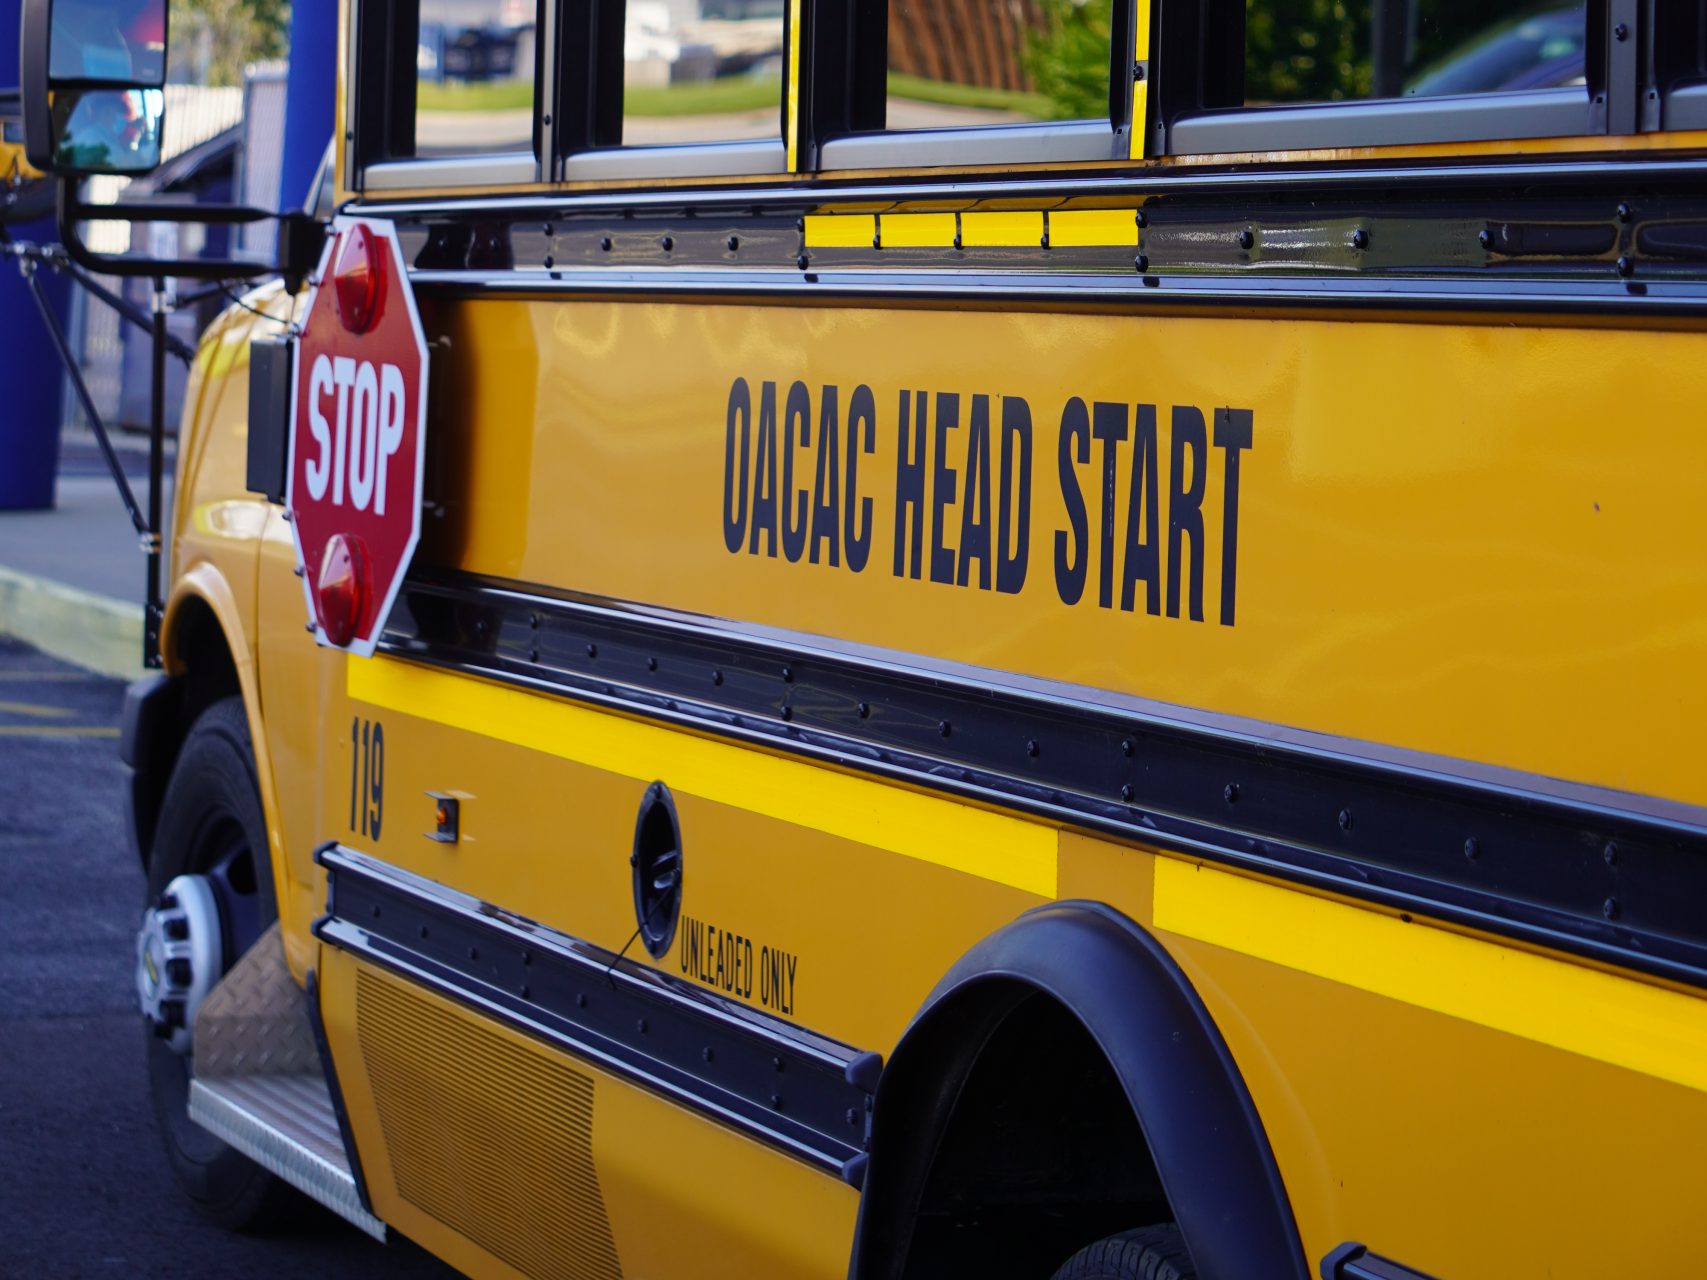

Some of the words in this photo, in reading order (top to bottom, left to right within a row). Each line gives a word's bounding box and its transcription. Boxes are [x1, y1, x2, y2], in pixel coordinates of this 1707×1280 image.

[305, 353, 406, 516] STOP
[723, 377, 876, 573] OACAC
[893, 389, 1033, 595] HEAD
[1054, 396, 1254, 627] START
[350, 716, 385, 842] 119
[681, 915, 753, 999] UNLEADED
[760, 945, 798, 1016] ONLY
